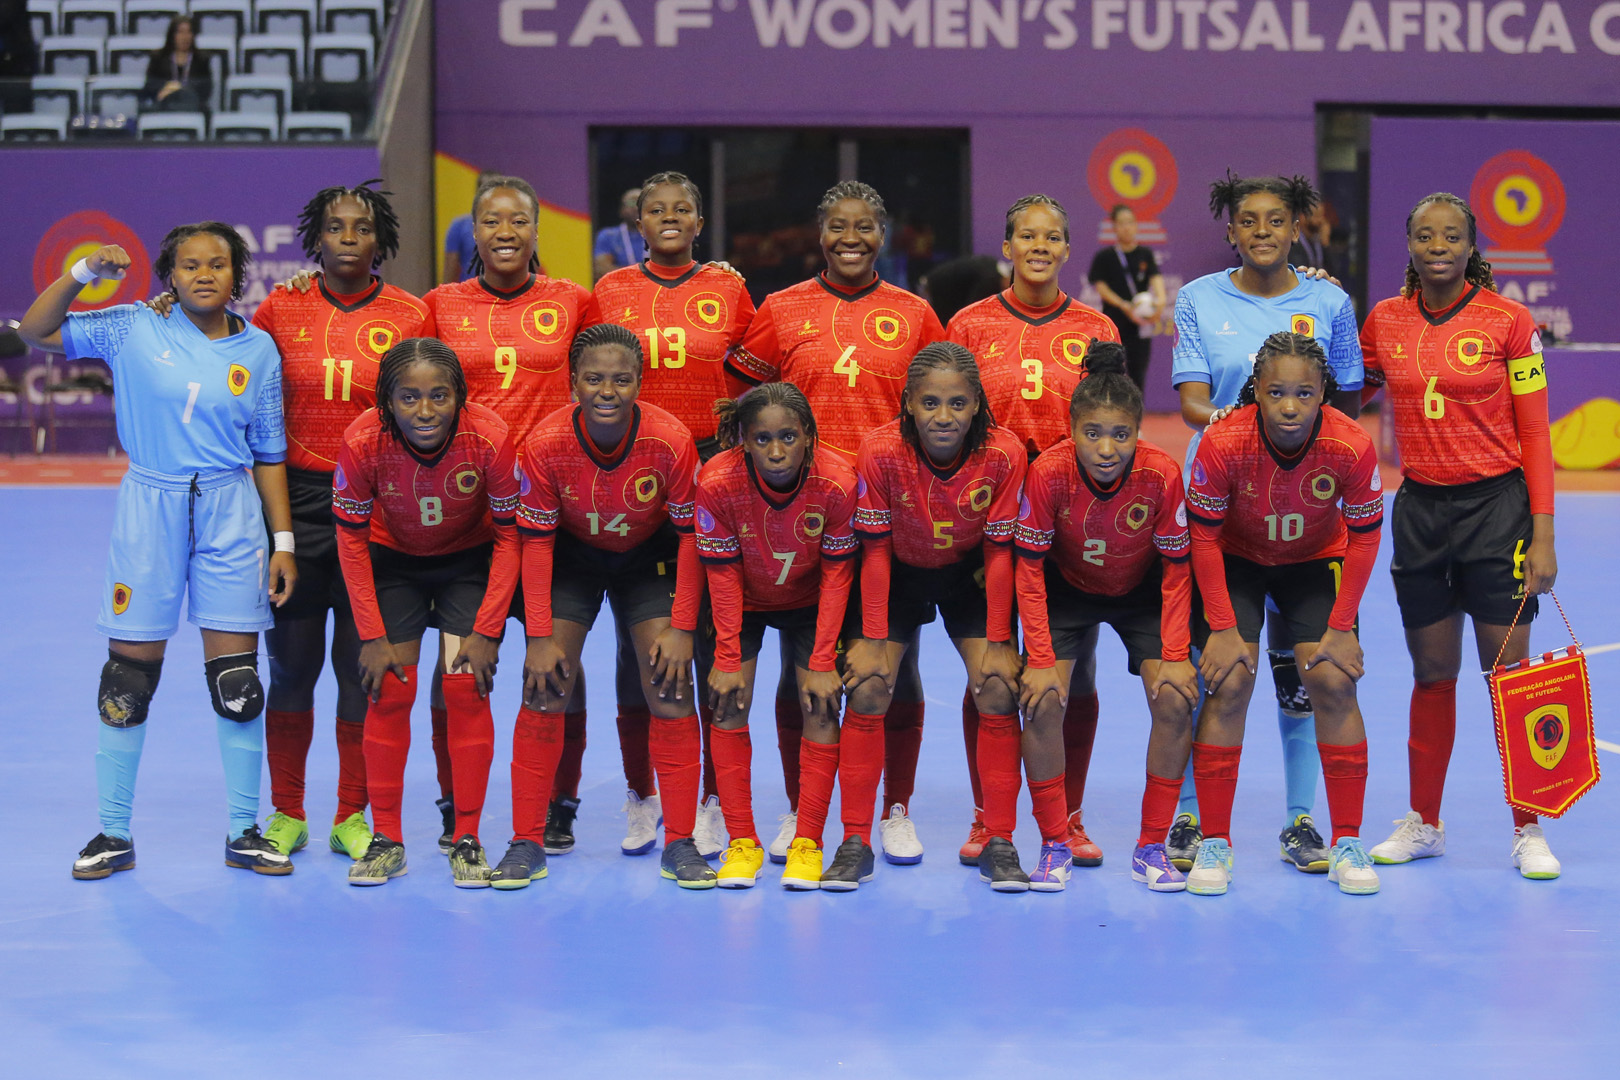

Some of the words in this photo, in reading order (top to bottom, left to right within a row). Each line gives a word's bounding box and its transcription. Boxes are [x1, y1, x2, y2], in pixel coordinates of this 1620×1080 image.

[748, 0, 1079, 49] WOMEN'S
[1092, 0, 1326, 51] FUTSAL
[1336, 0, 1577, 54] AFRICA
[645, 327, 686, 369] 13
[322, 358, 353, 401] 11
[494, 346, 517, 389] 9
[833, 345, 860, 388] 4
[1021, 359, 1043, 400] 3
[182, 381, 201, 424] 1
[1423, 376, 1445, 419] 6
[419, 496, 443, 526] 8
[586, 512, 631, 537] 14
[1264, 513, 1304, 542] 10
[933, 521, 953, 550] 5
[1082, 539, 1106, 566] 2
[772, 551, 797, 585] 7
[1507, 682, 1544, 696] FEDERAÇÃO
[1545, 673, 1576, 687] ANGOLANA
[1526, 692, 1534, 700] DE
[1535, 686, 1562, 698] FUTEBOL
[1532, 784, 1555, 795] FUNDADA
